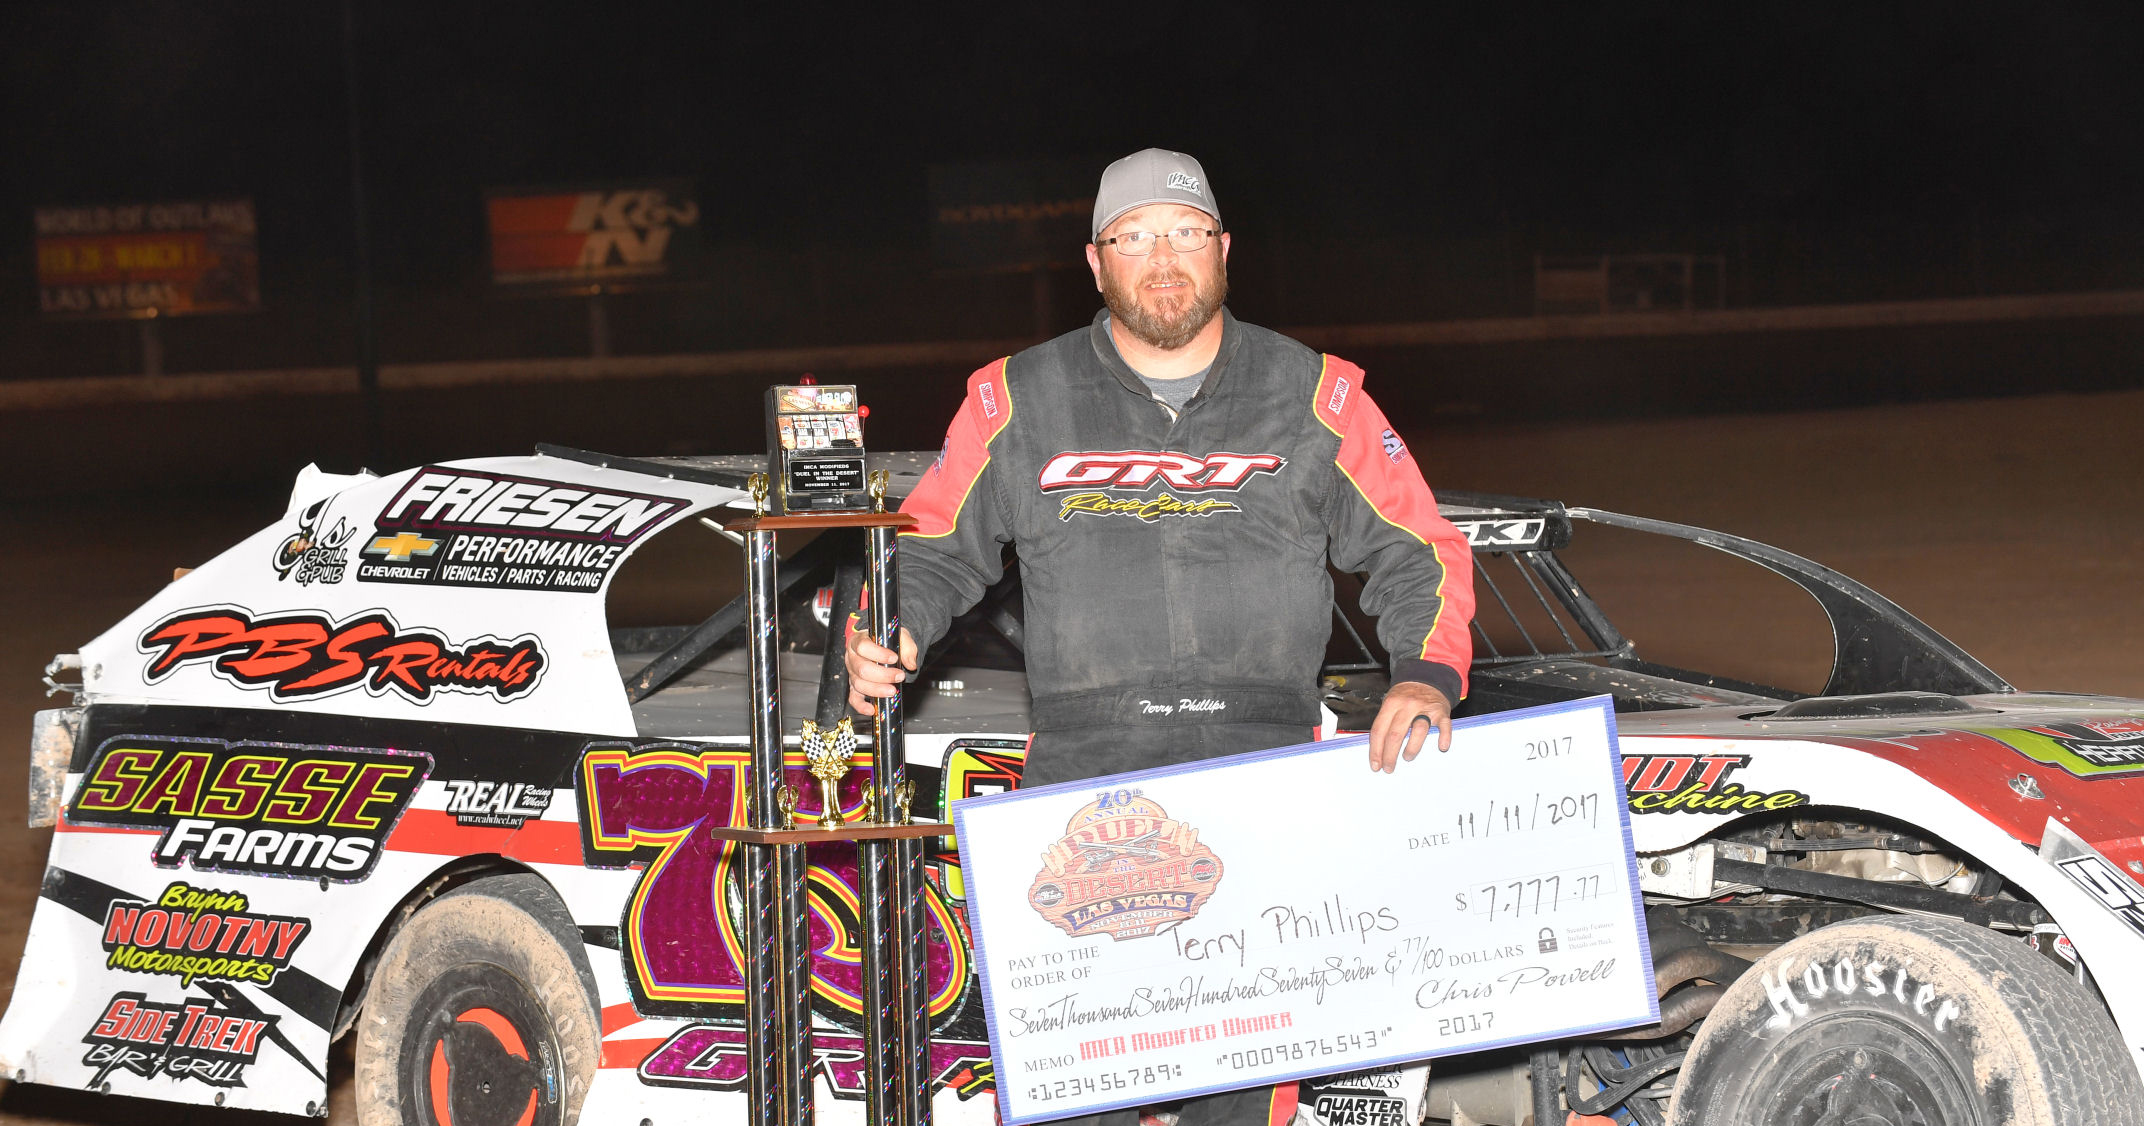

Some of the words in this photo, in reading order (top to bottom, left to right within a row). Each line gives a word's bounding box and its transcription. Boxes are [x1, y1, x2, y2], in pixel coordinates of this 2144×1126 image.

[1330, 378, 1349, 412] SIMPSON
[1039, 451, 1284, 492] GRT
[385, 472, 676, 538] FRIESEN
[303, 547, 348, 566] GRILL
[448, 534, 623, 569] PERFORMANCE
[360, 565, 432, 580] CHEVROLET
[442, 564, 499, 583] VEHICLES
[507, 568, 547, 586] PARTS
[555, 570, 602, 588] RACING
[148, 616, 390, 693] PBS
[1139, 699, 1174, 717] Terry
[1178, 698, 1227, 714] Phillips
[1525, 736, 1573, 761] 2017
[77, 748, 414, 831] SASSE
[447, 780, 542, 816] REAL
[523, 784, 552, 798] Racing
[1627, 782, 1804, 810] chine
[1083, 806, 1149, 823] ANNUAL
[1408, 833, 1451, 850] DATE
[1112, 864, 1136, 873] THE
[1063, 860, 1188, 907] DESERT
[160, 884, 247, 924] Brynn
[1071, 900, 1114, 926] LAS
[1117, 893, 1188, 910] VEGAS
[1455, 892, 1468, 911] $
[1090, 910, 1174, 931] NOVEMBER
[1156, 916, 1246, 968] Terry
[1260, 894, 1399, 945] Phillips
[105, 907, 306, 960] NOVOTNY
[108, 945, 275, 986] Motorsports
[1008, 954, 1039, 972] PAY
[1041, 951, 1063, 967] TO
[1067, 946, 1100, 962] THE
[1449, 944, 1525, 968] DOLLARS
[1010, 969, 1067, 990] ORDER
[1070, 966, 1093, 982] OF
[1415, 978, 1494, 1010] Chris
[1496, 957, 1617, 996] Powell
[1760, 957, 1960, 1033] Hoosier
[1438, 1012, 1495, 1037] 2017
[169, 1055, 245, 1082] GRILL
[1024, 1053, 1075, 1074] MEMO
[1333, 1073, 1403, 1089] HARNESS
[1317, 1097, 1404, 1118] QUARTER
[1329, 1111, 1404, 1126] MASTER
